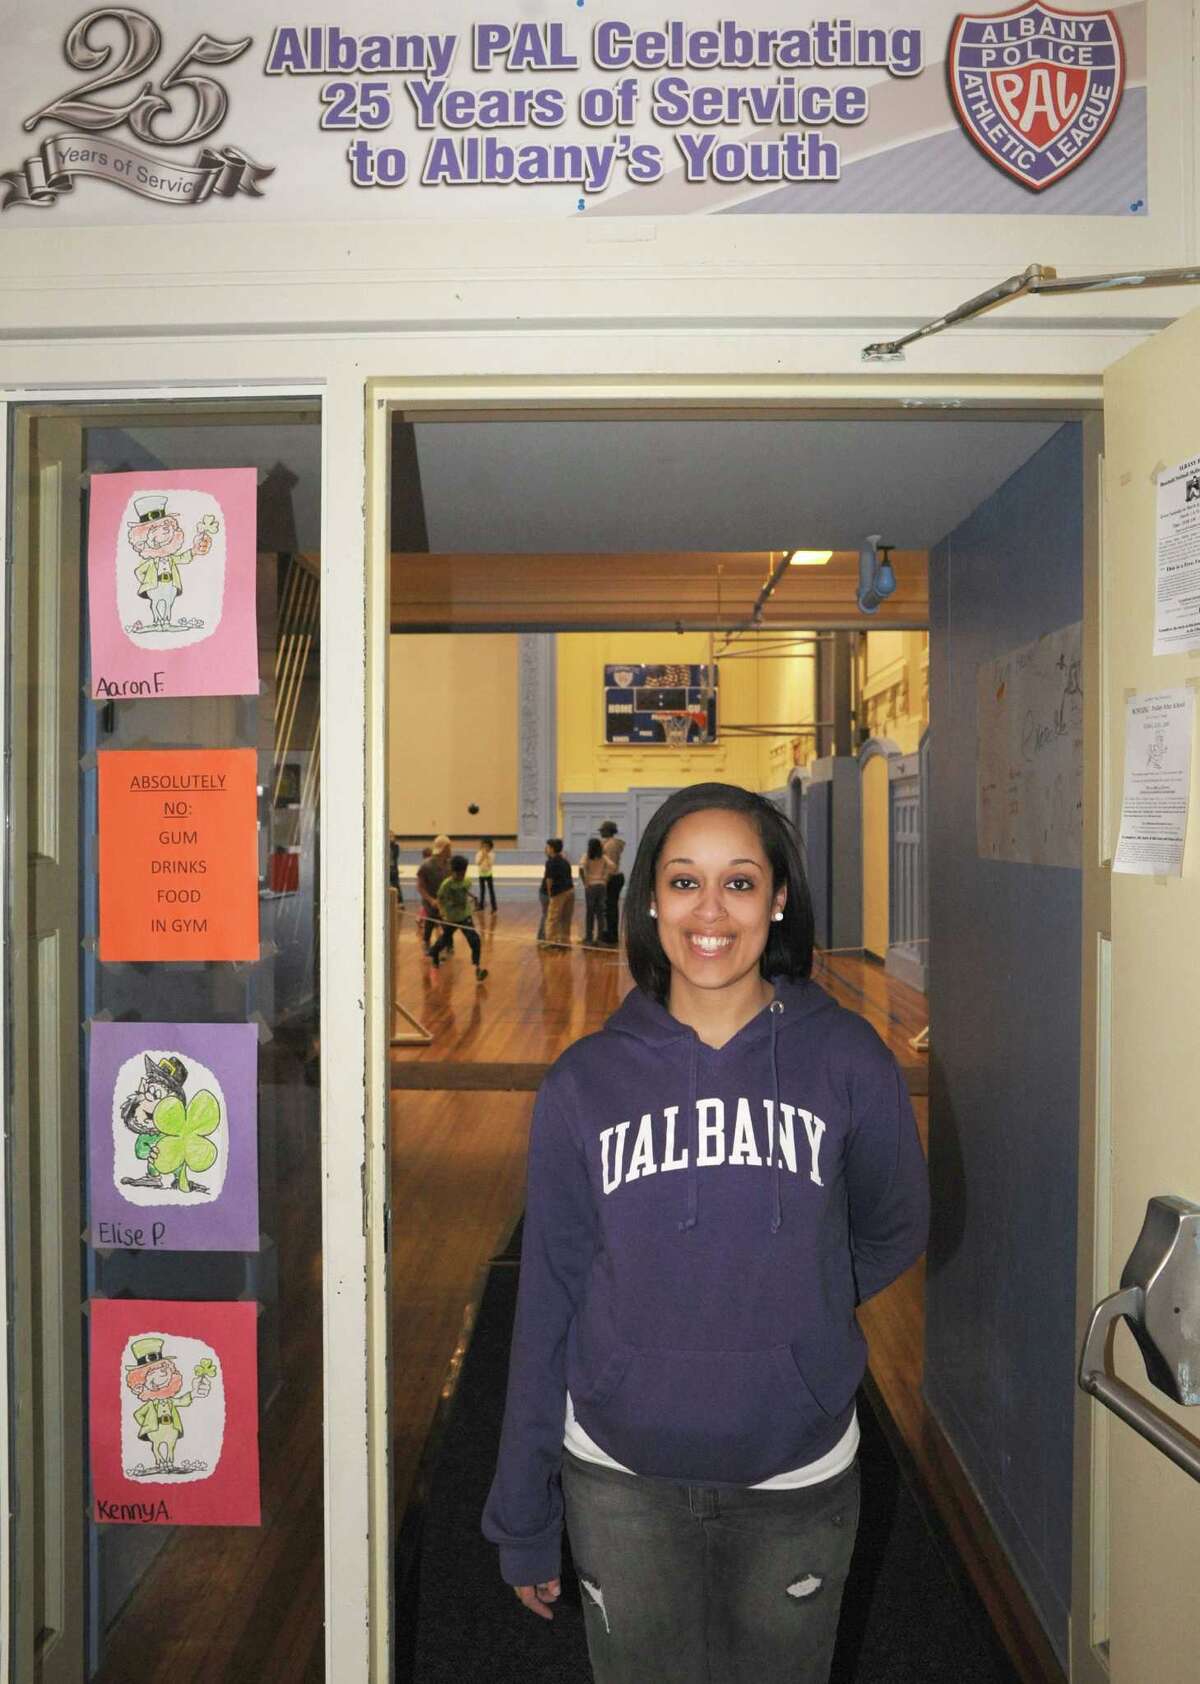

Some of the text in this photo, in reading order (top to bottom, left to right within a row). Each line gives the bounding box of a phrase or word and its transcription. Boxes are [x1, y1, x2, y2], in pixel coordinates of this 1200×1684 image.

[981, 17, 1094, 43] ALBANY
[267, 18, 924, 79] Albany PAL Celebrating
[981, 41, 1093, 67] POLICE
[23, 7, 254, 146] 25
[322, 75, 869, 128] 25 Years of Service
[996, 69, 1078, 133] PAL
[964, 73, 1036, 170] ATHLETIC
[1046, 83, 1111, 168] LEAGUE
[57, 145, 200, 195] Years of Servic
[350, 139, 408, 185] to
[678, 131, 841, 181] Youth
[95, 677, 151, 697] Aaron
[129, 774, 227, 792] ABSOLUTELY
[158, 831, 198, 846] GUM
[151, 860, 207, 874] DRINKS
[156, 889, 201, 904] FOOD
[151, 919, 208, 933] IN GYM
[599, 1097, 827, 1196] UALBANY
[98, 1222, 146, 1247] Elise
[97, 1500, 154, 1523] Kenny
